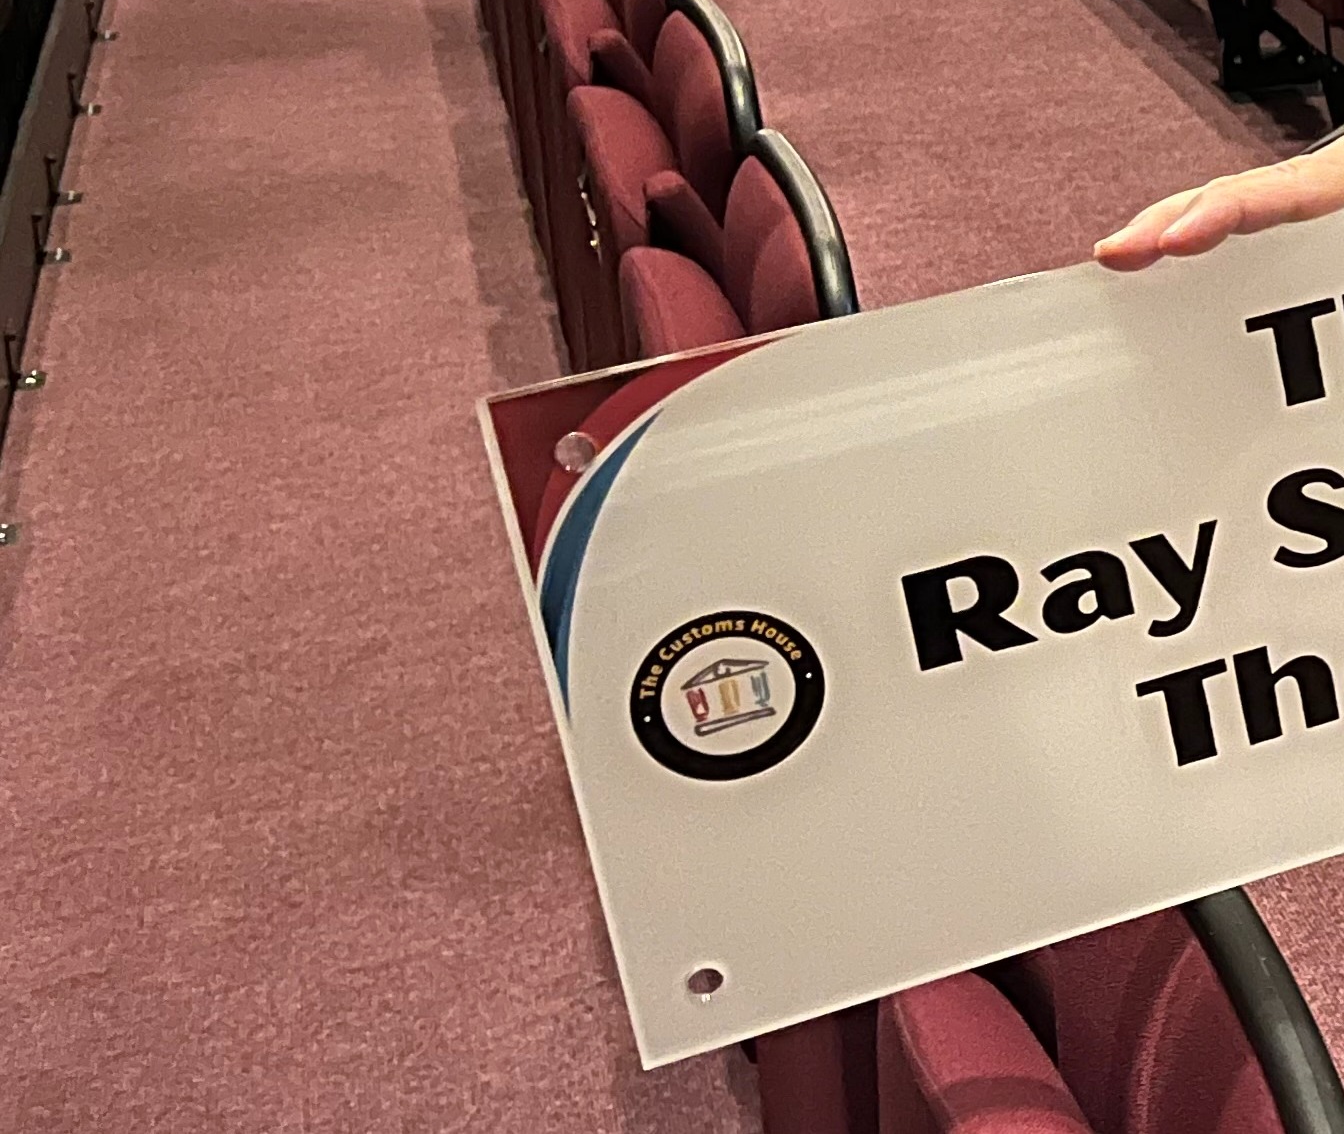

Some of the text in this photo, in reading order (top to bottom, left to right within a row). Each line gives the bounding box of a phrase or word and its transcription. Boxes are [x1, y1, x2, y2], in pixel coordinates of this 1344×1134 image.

[901, 519, 1218, 672] Ray
[639, 619, 803, 700] The Customs House
